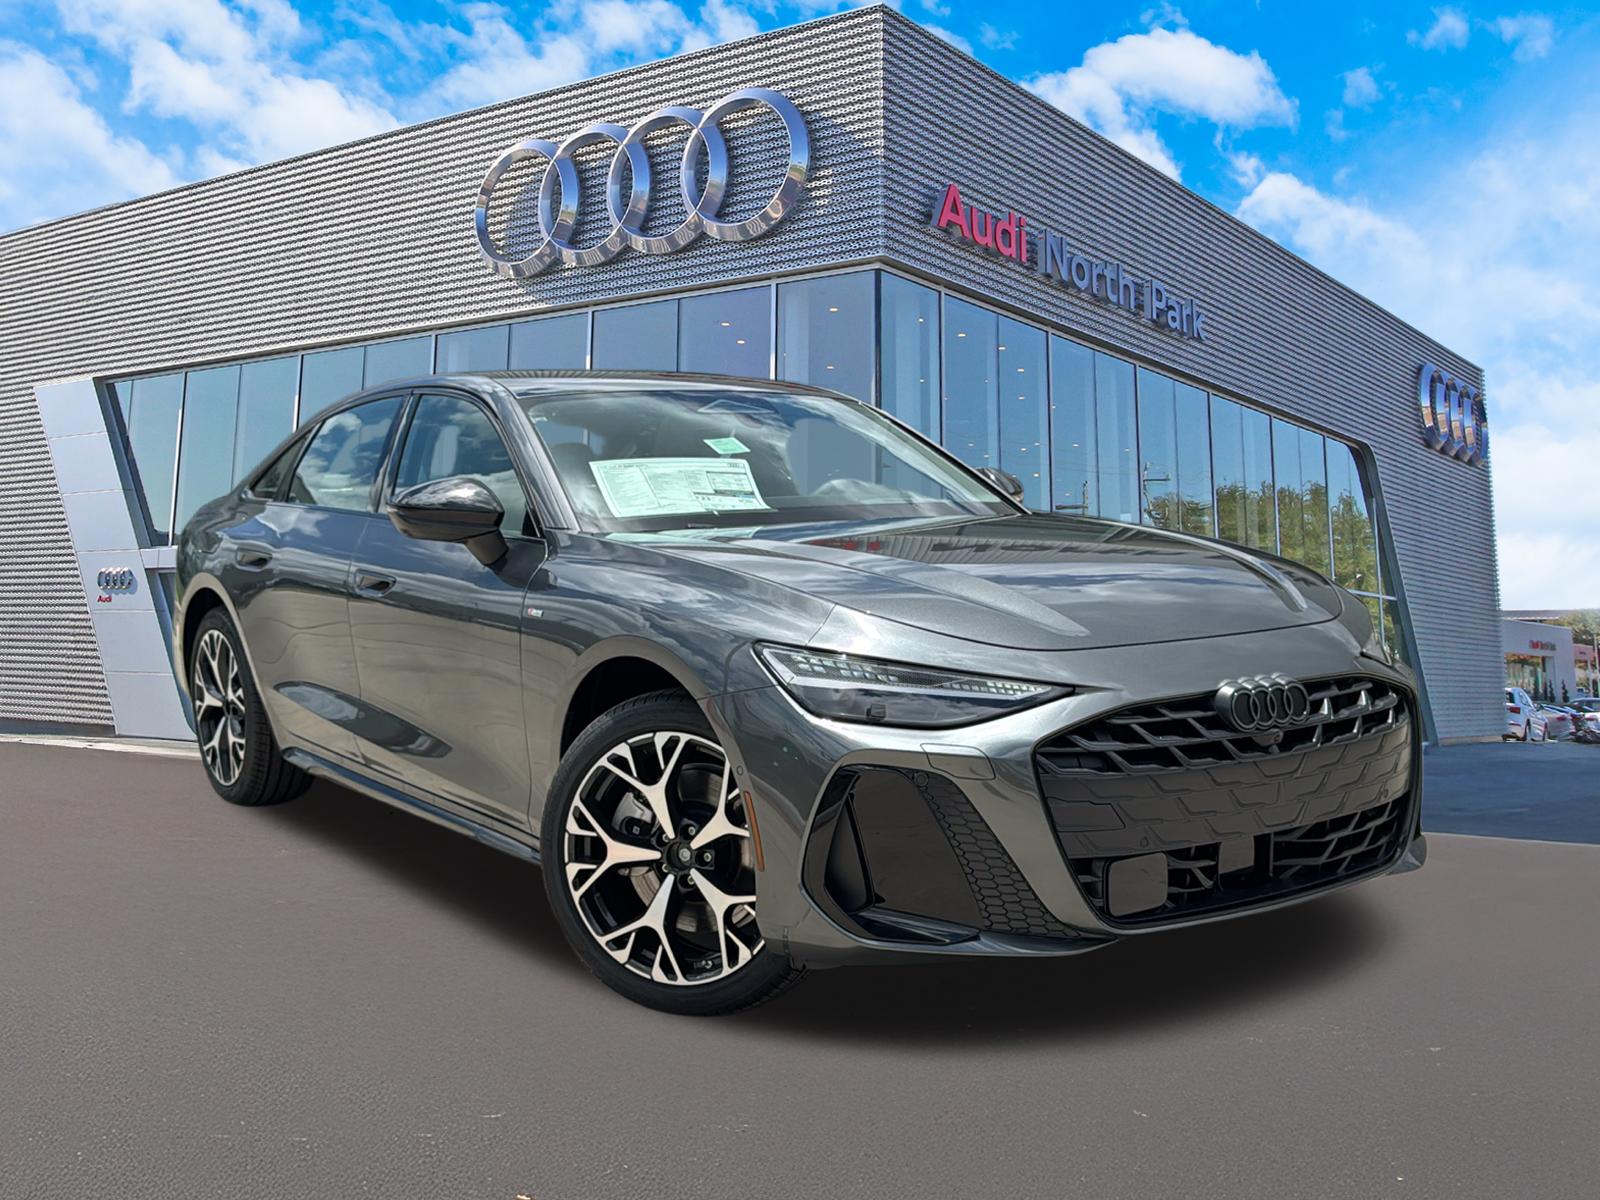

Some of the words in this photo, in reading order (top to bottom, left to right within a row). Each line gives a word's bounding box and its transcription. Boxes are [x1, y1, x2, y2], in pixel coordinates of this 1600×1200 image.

[934, 183, 1028, 264] Audi
[1040, 228, 1137, 310] North
[1146, 278, 1207, 341] Park
